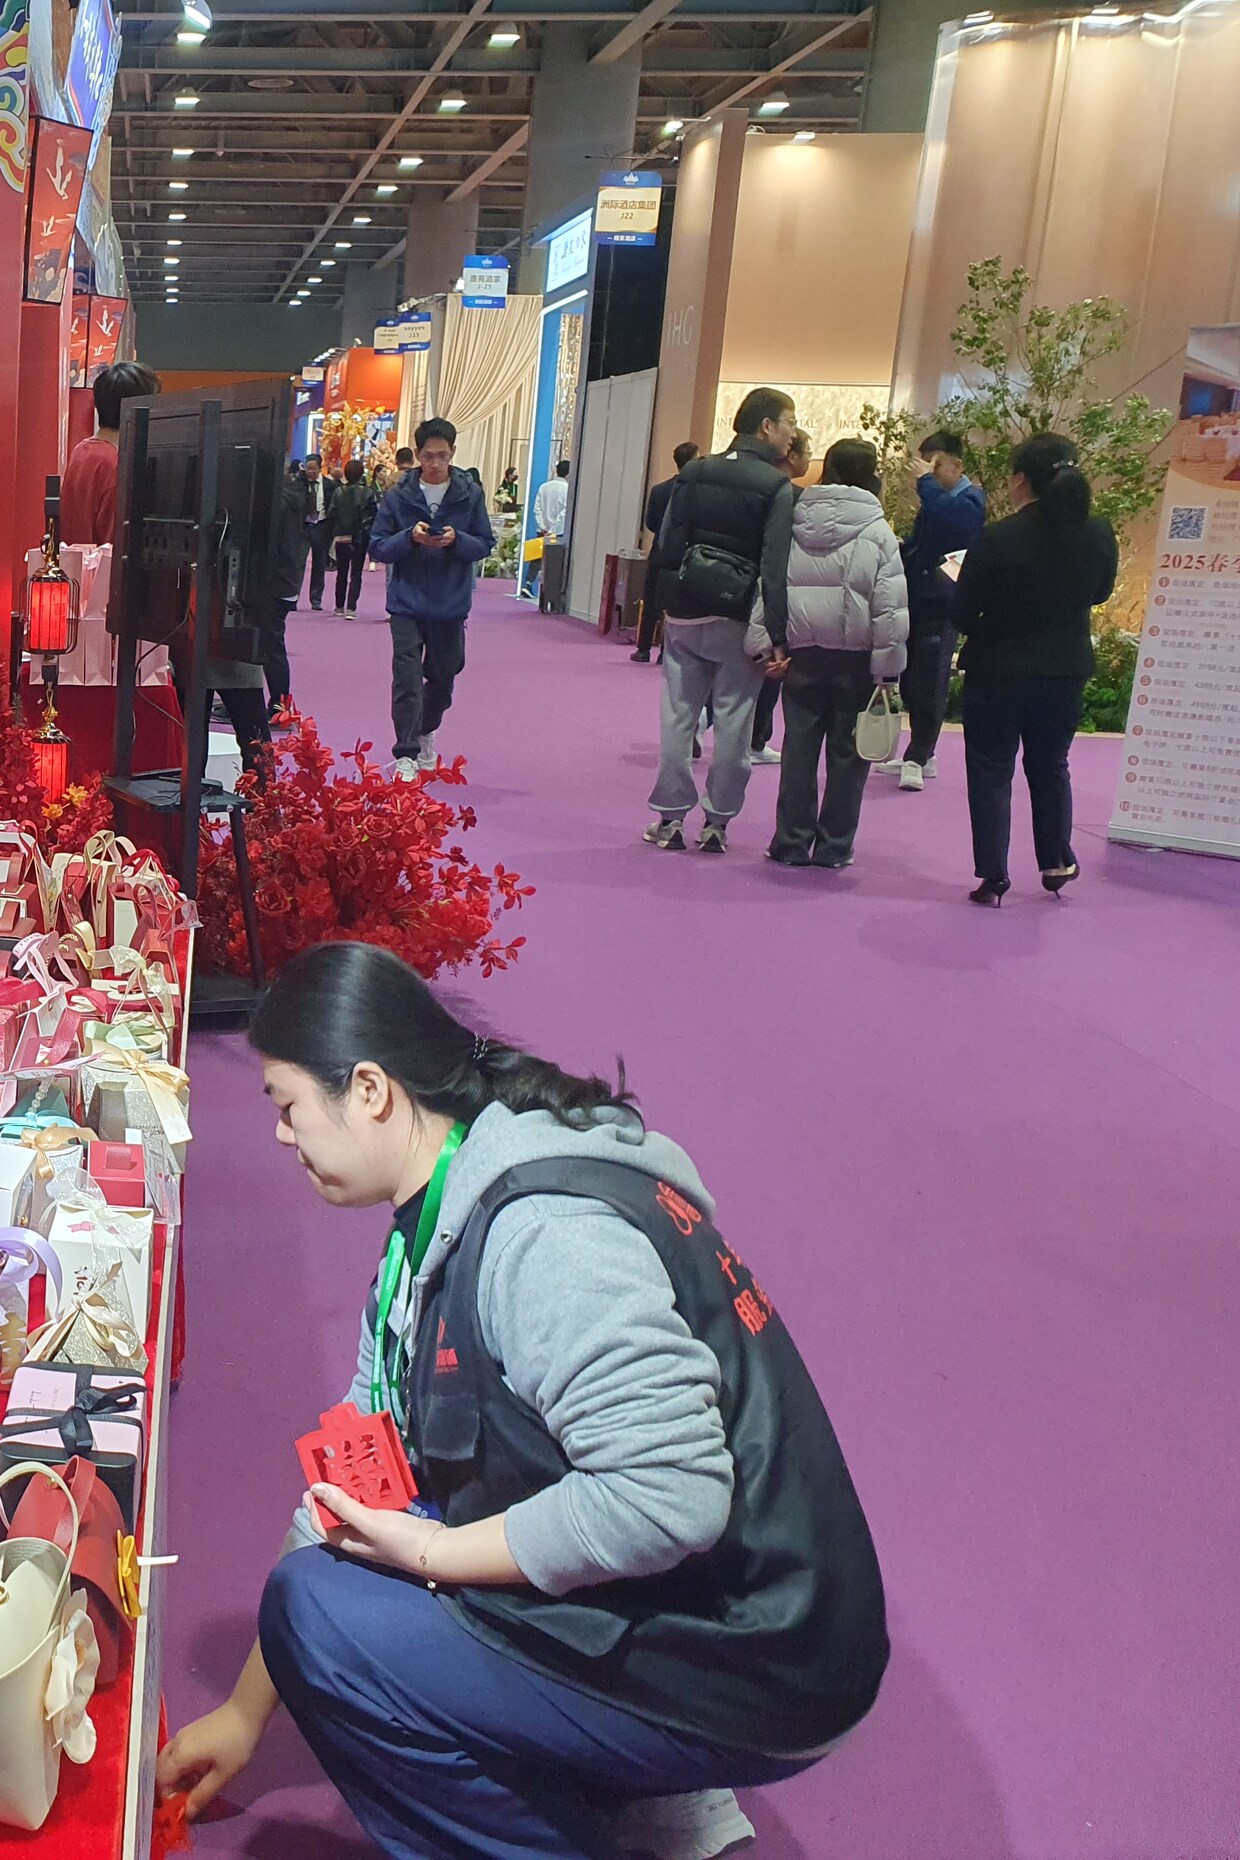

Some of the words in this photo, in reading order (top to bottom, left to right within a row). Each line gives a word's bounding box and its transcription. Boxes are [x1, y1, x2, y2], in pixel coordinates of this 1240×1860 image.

[600, 199, 657, 211] 洲际酒店集团
[665, 305, 695, 348] IHG
